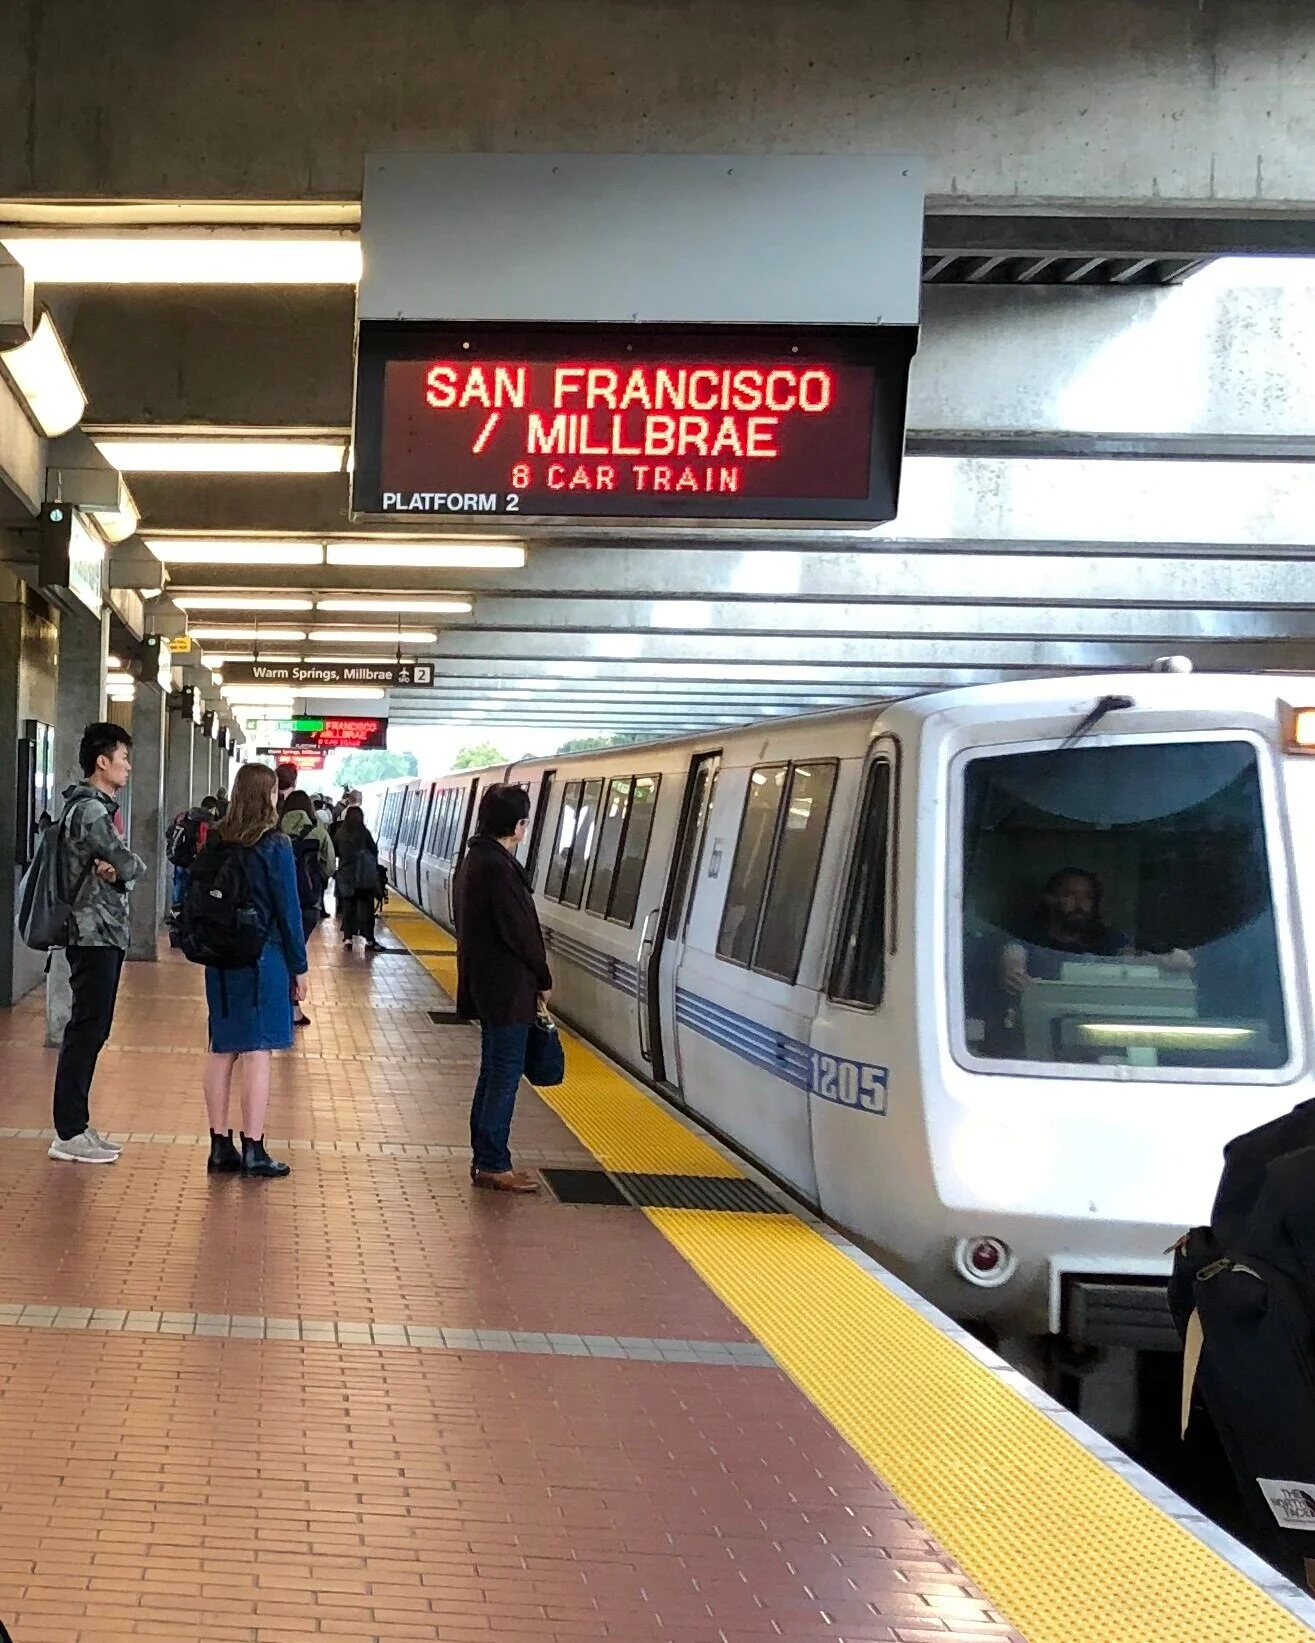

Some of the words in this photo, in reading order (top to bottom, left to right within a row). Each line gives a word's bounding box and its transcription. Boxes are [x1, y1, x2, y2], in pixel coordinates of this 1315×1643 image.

[425, 366, 526, 409] SAN
[553, 367, 832, 412] FRANCISCO
[472, 412, 500, 455] /
[526, 413, 780, 457] MILLBRAE
[511, 464, 530, 489] 8
[547, 464, 615, 490] CAR
[632, 465, 739, 492] TRAIN
[382, 492, 497, 511] PLATFORM
[505, 493, 520, 511] 2
[252, 667, 289, 679] Warm
[292, 667, 340, 681] Springs,
[343, 668, 393, 680] Millbrae
[417, 669, 426, 681] 2
[810, 1053, 886, 1112] 1205
